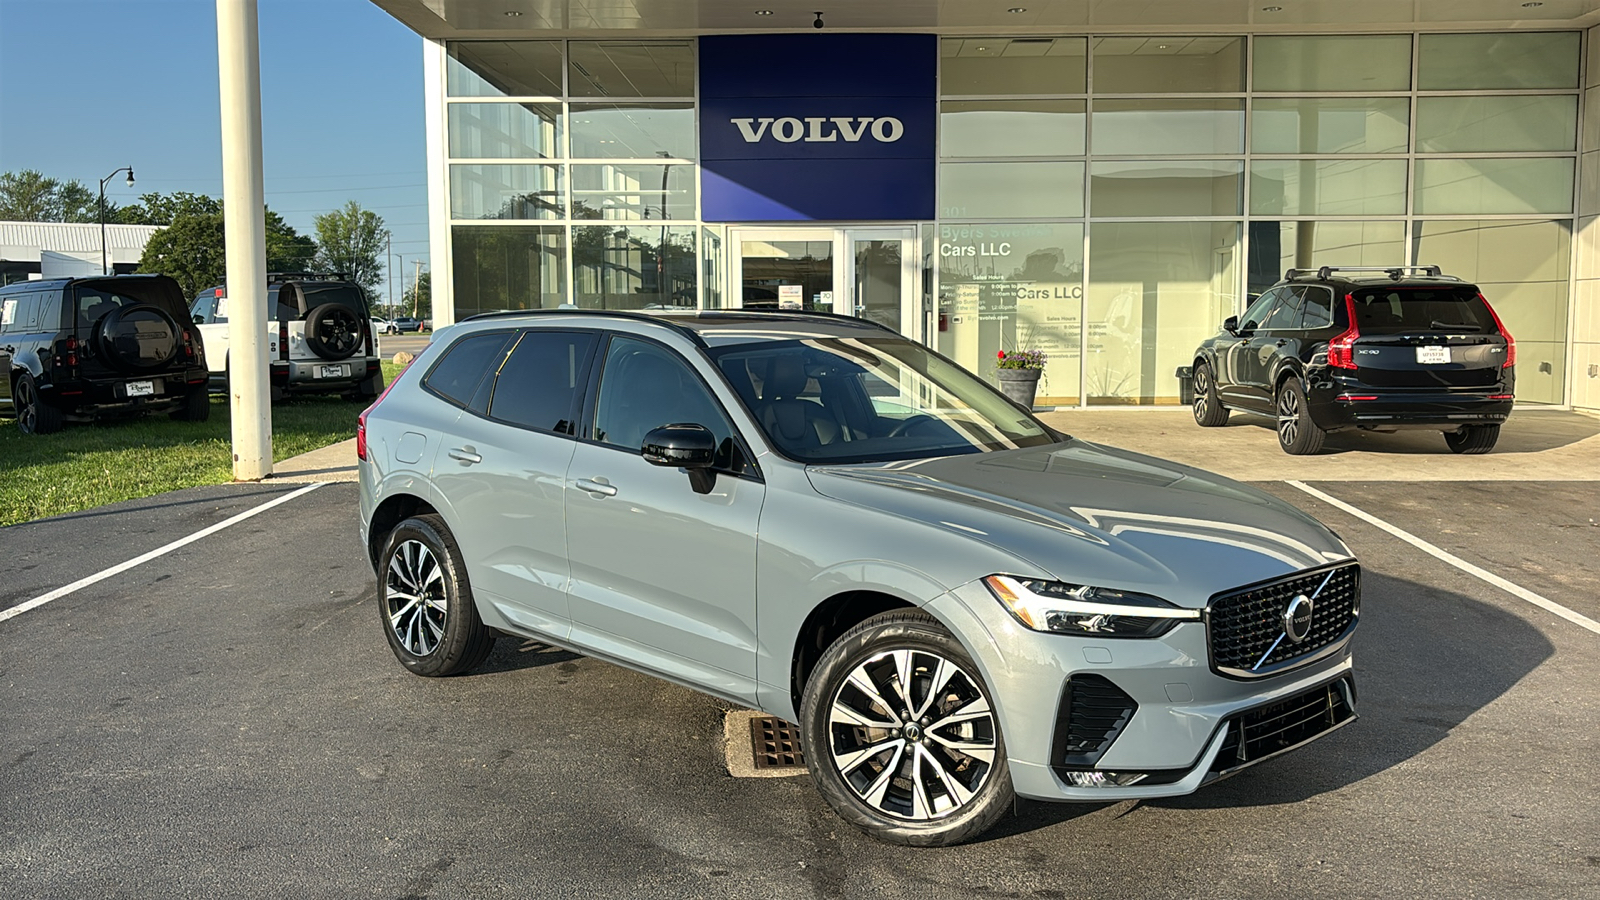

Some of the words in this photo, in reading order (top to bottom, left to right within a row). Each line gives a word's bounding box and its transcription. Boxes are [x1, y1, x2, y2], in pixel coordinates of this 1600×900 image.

[730, 116, 904, 143] VOLVO
[942, 207, 967, 218] 301
[941, 226, 984, 242] Byers
[940, 243, 976, 256] Cars
[981, 242, 1011, 256] LLC
[1016, 287, 1049, 299] Cars
[1054, 286, 1082, 299] LLC
